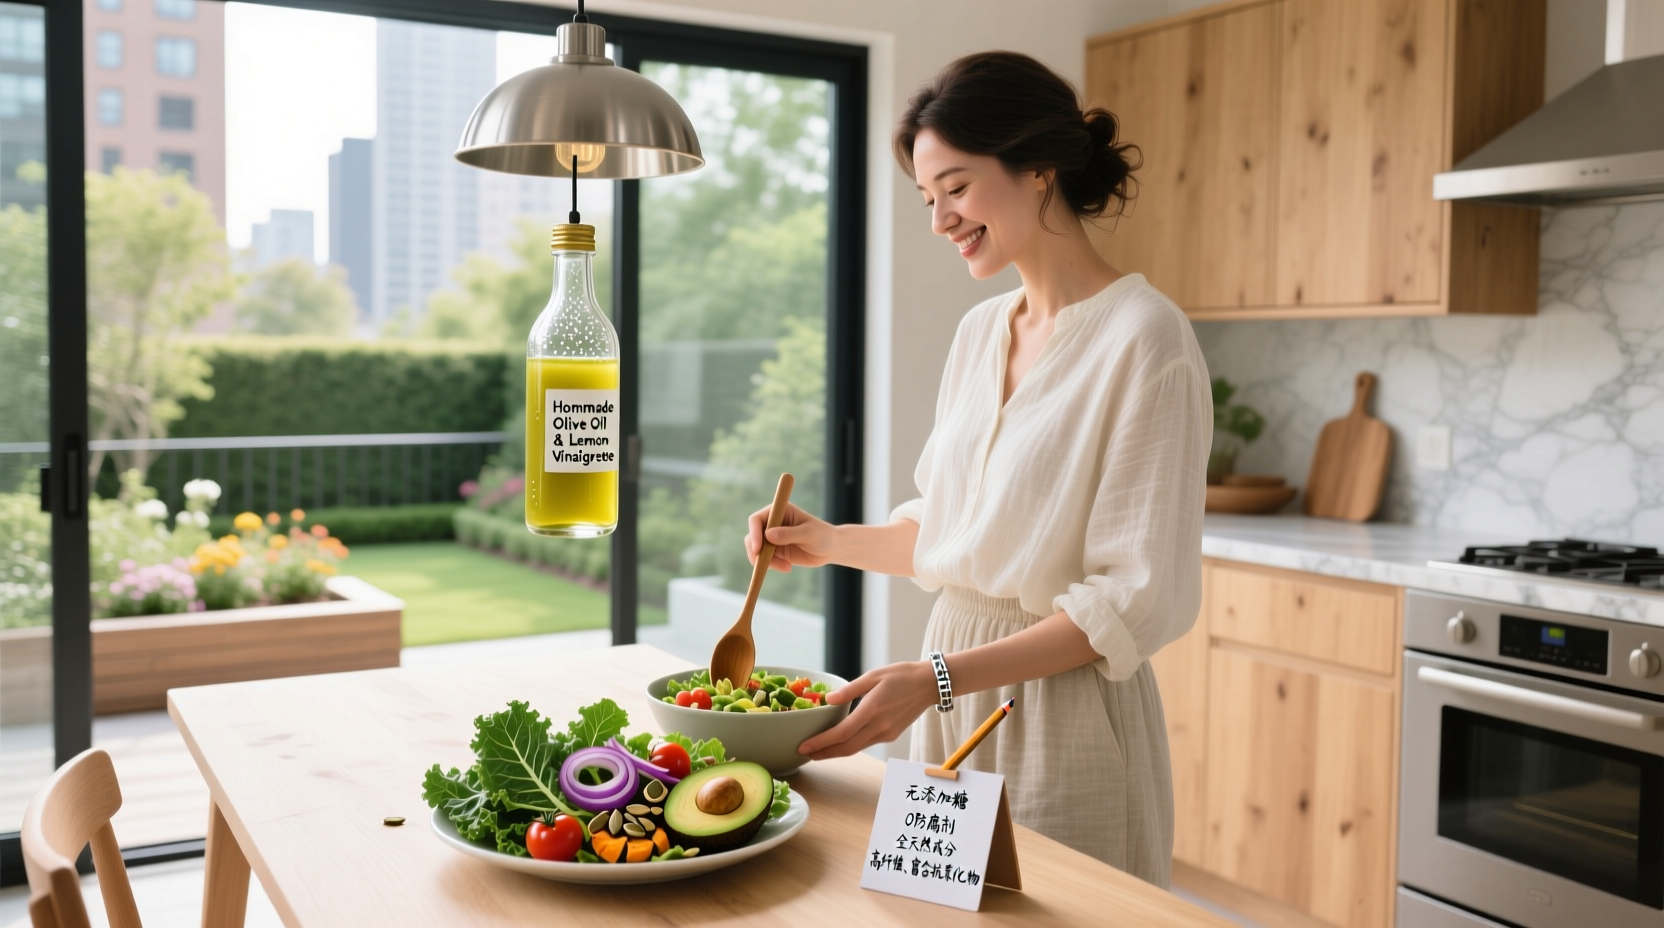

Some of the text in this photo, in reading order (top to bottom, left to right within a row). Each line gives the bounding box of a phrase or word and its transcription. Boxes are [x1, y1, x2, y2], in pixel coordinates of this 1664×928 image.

[553, 400, 614, 413] Hommade
[553, 416, 587, 430] Olive
[553, 433, 609, 446] & Lemon
[905, 785, 968, 810] 无添加糖
[896, 833, 957, 857] 全天然成分
